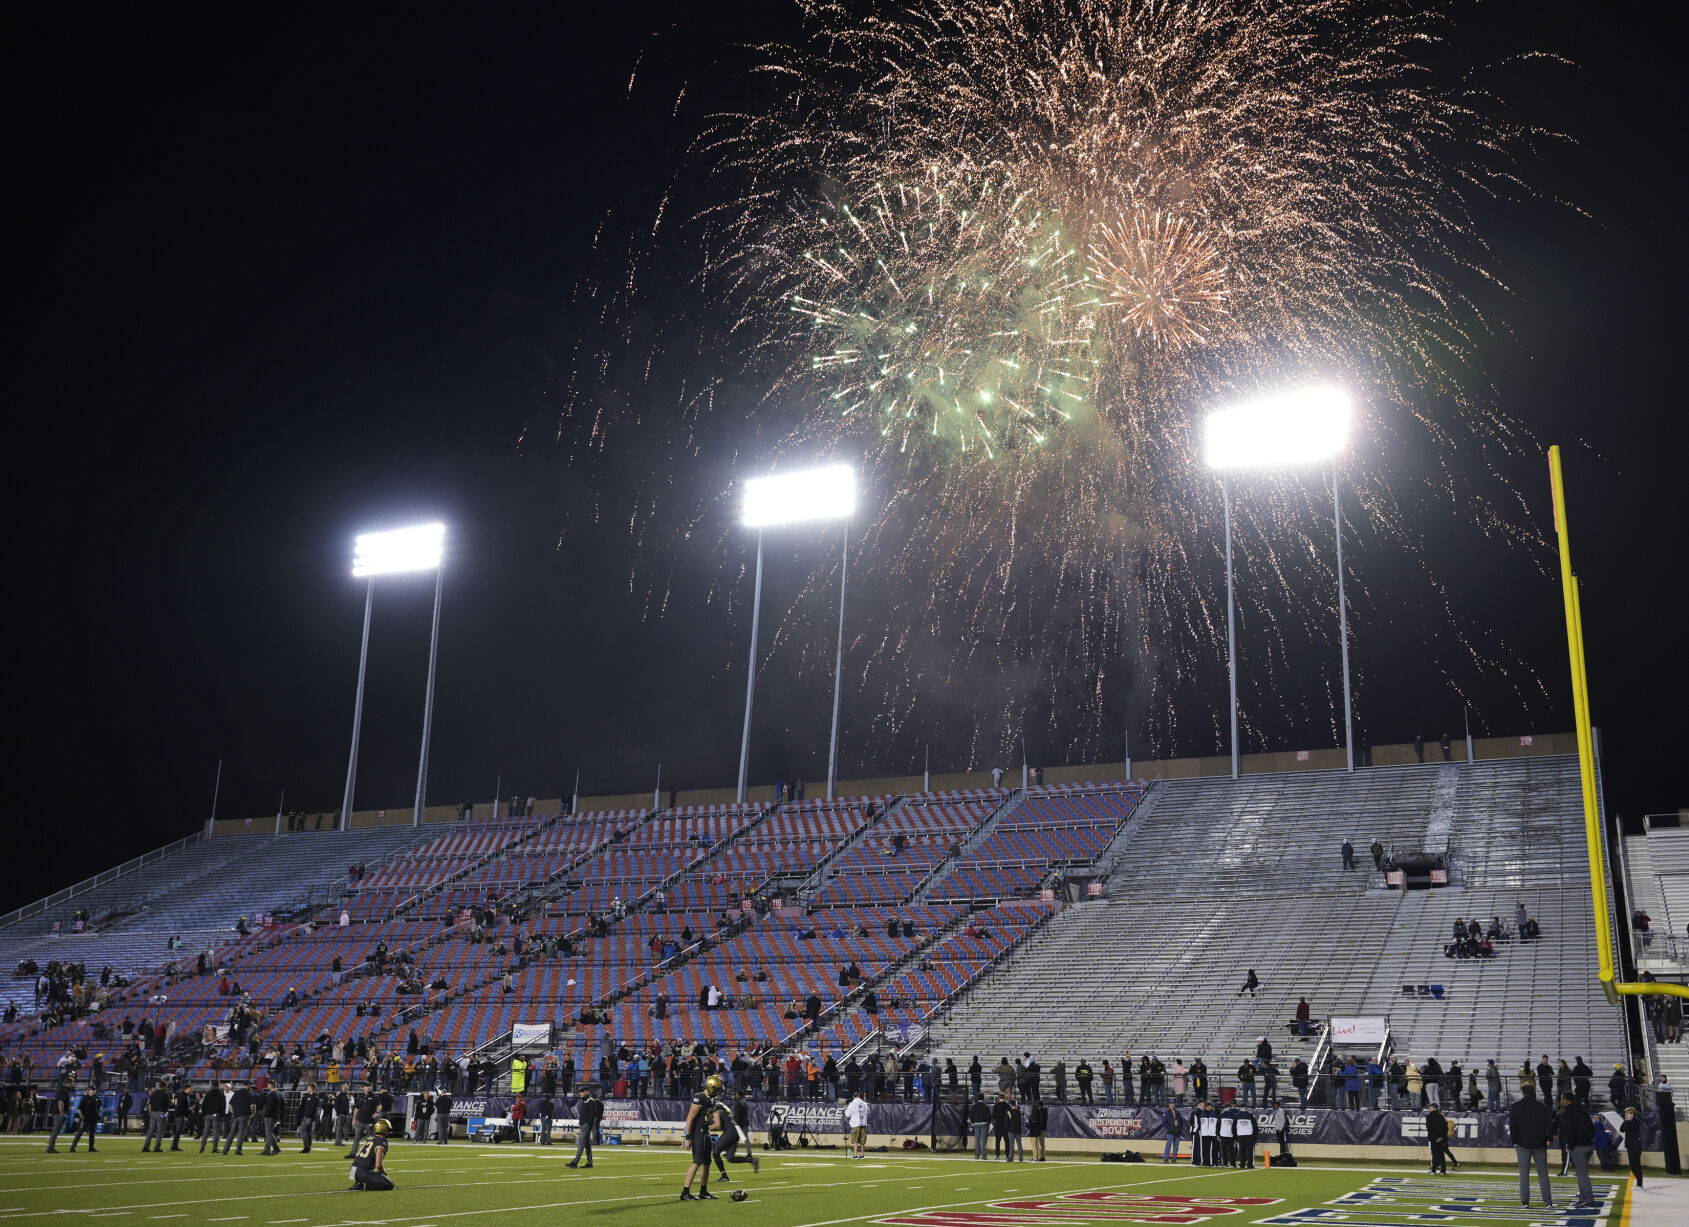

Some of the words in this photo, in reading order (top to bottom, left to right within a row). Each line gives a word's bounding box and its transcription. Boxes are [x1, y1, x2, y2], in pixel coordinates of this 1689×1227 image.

[767, 1104, 844, 1124] RADIANCE
[1089, 1118, 1142, 1128] INDEPENDENCE
[1102, 1126, 1129, 1135] BOWL
